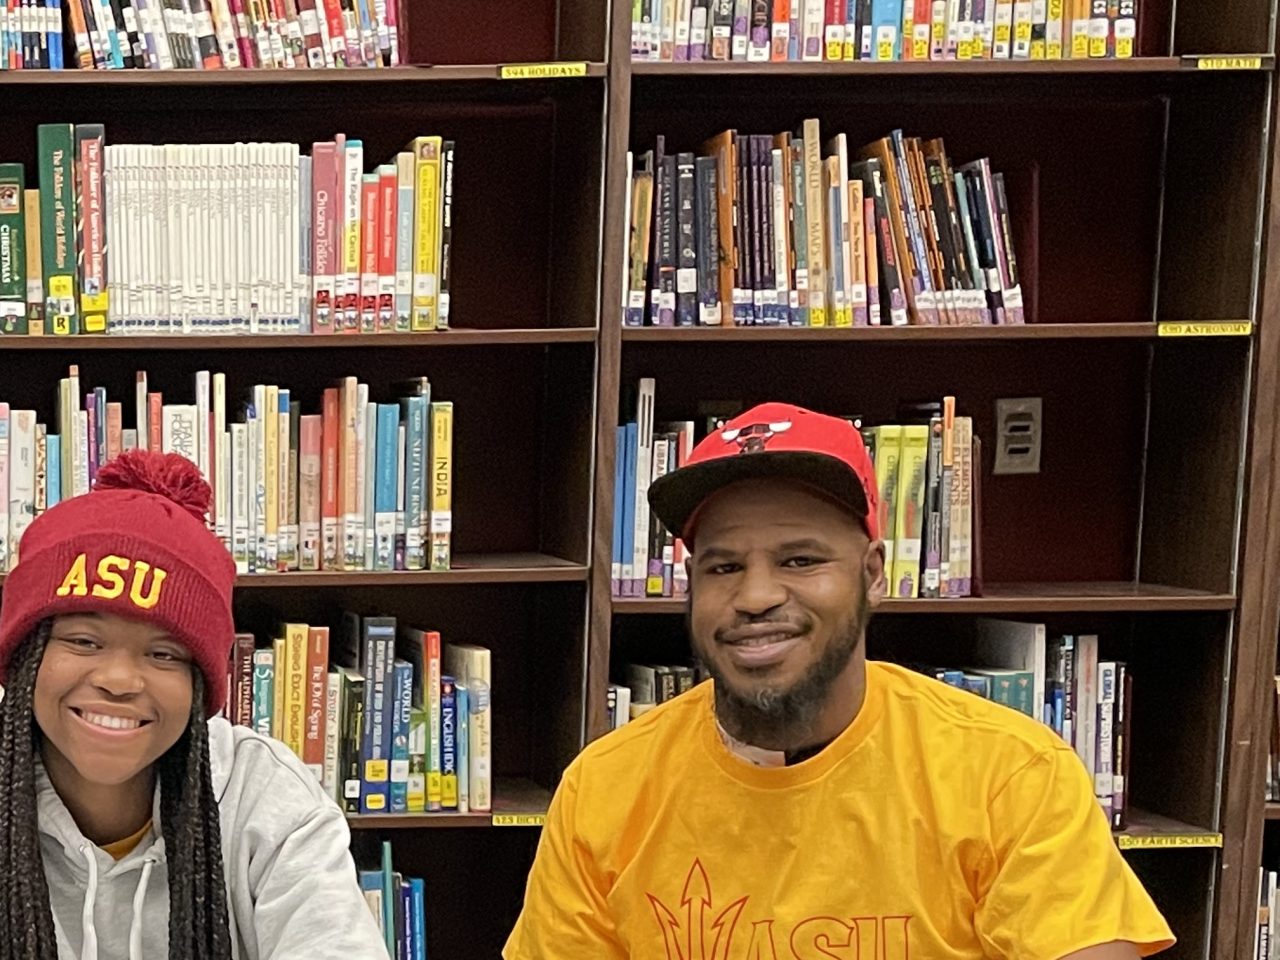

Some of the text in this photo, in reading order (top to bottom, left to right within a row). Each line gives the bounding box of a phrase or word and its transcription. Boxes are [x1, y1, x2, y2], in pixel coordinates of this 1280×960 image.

[528, 67, 581, 76] HOLIDAYS
[1225, 59, 1256, 68] MATH
[54, 150, 64, 165] The
[89, 143, 98, 160] The
[54, 167, 64, 199] Folklore
[809, 140, 821, 256] WORLD MAPS
[56, 211, 66, 234] World
[315, 190, 328, 236] Chicano
[347, 167, 358, 262] The Eagle on the Cactus
[91, 210, 101, 252] American
[0, 224, 11, 283] CHRISTMAS
[55, 235, 66, 268] Holidays
[56, 318, 65, 329] R
[1184, 323, 1248, 334] ASTRONOMY
[411, 438, 423, 492] NEPTUNE
[435, 456, 449, 497] INDIA
[961, 446, 970, 506] ELEMENTS
[56, 552, 168, 609] ASU
[256, 668, 272, 679] 5
[290, 633, 303, 743] SIGNING EXACT ENGLISH
[312, 665, 324, 680] The
[1102, 669, 1112, 700] GLOBAL
[312, 681, 324, 699] JOY
[401, 678, 411, 723] WORLD
[328, 690, 337, 723] STORY
[307, 709, 322, 740] Signing
[443, 708, 453, 752] ENGLISH
[1141, 837, 1176, 846] EARTH
[1179, 836, 1221, 846] SCIENCE
